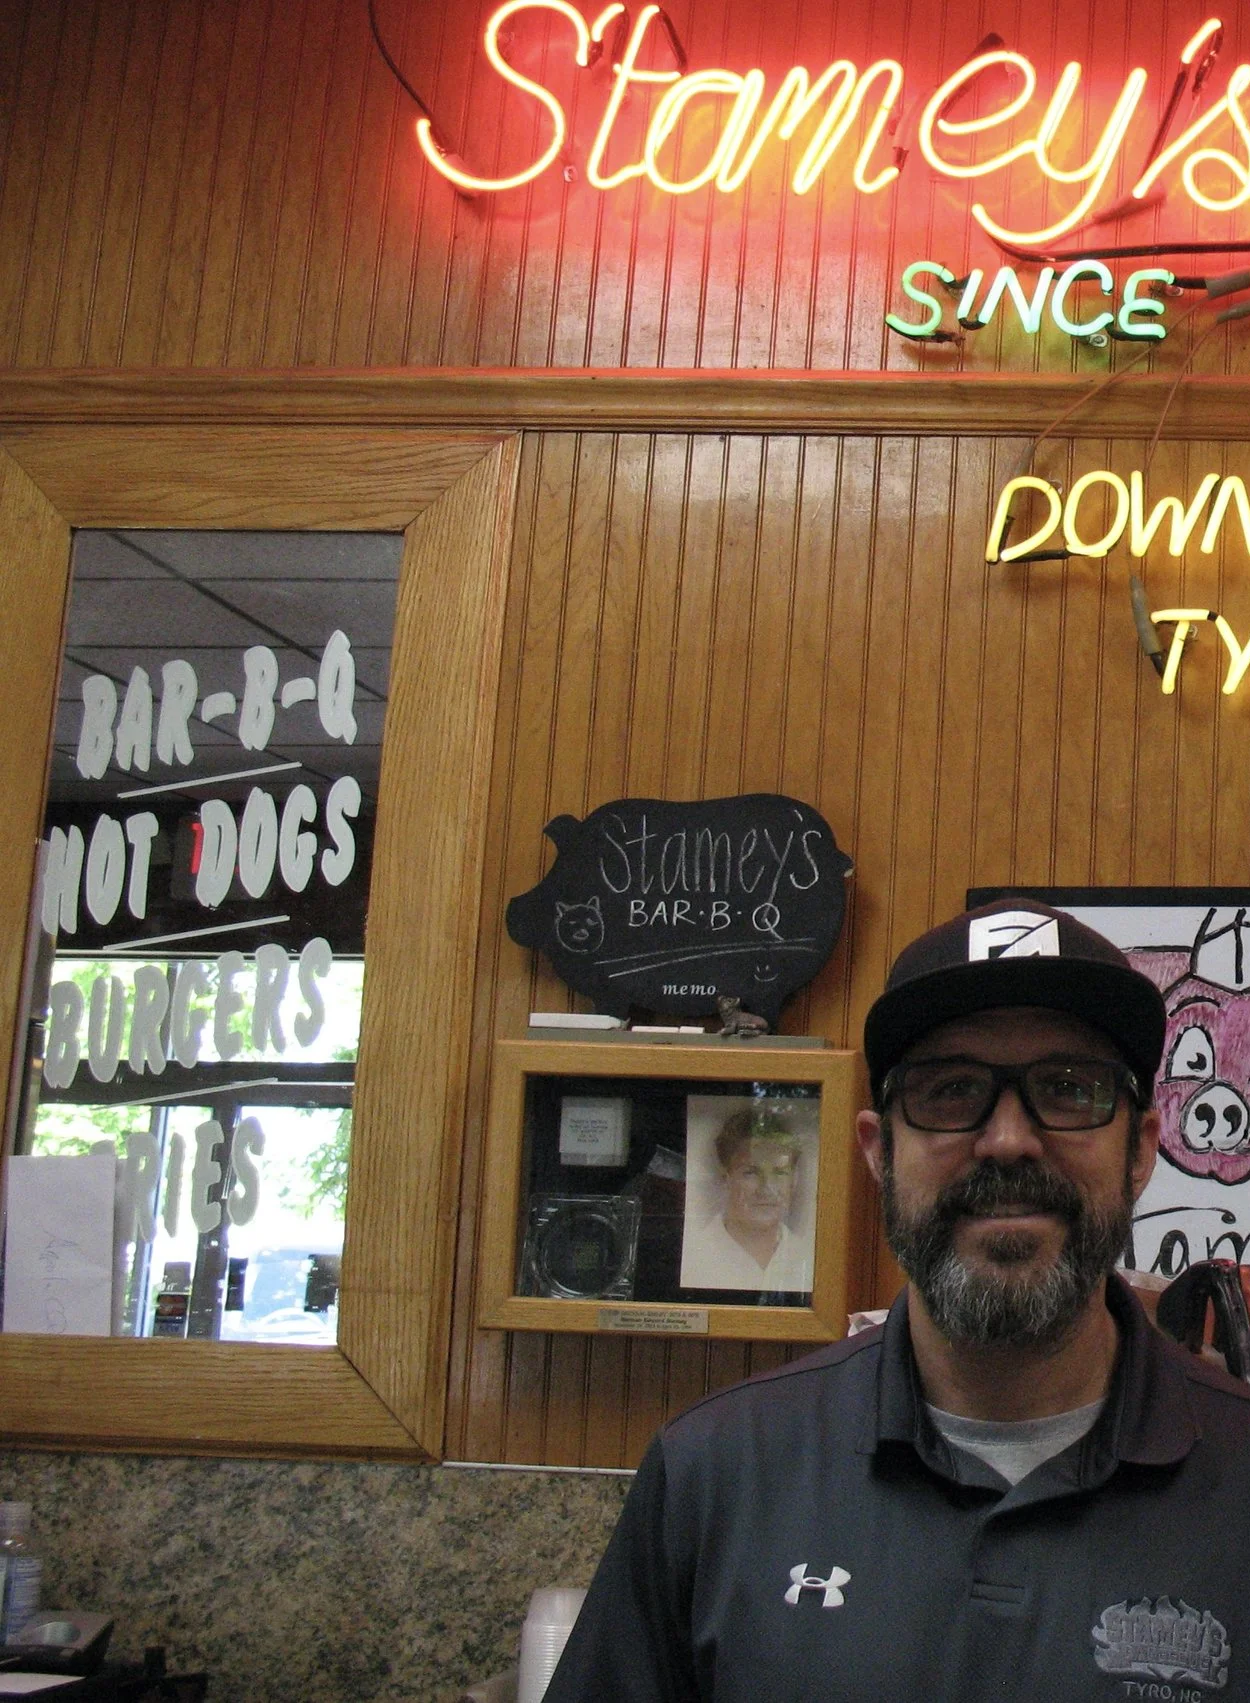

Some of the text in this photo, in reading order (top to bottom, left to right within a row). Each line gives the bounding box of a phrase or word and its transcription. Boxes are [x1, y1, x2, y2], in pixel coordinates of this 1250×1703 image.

[886, 260, 1175, 337] SINCE
[76, 629, 358, 780] BAR-B-Q
[41, 812, 159, 935] HOT
[195, 775, 362, 909] DOGS
[600, 809, 822, 925] Stamey's
[44, 936, 333, 1089] BURGERS
[662, 983, 717, 996] memo
[89, 1115, 267, 1245] RIES
